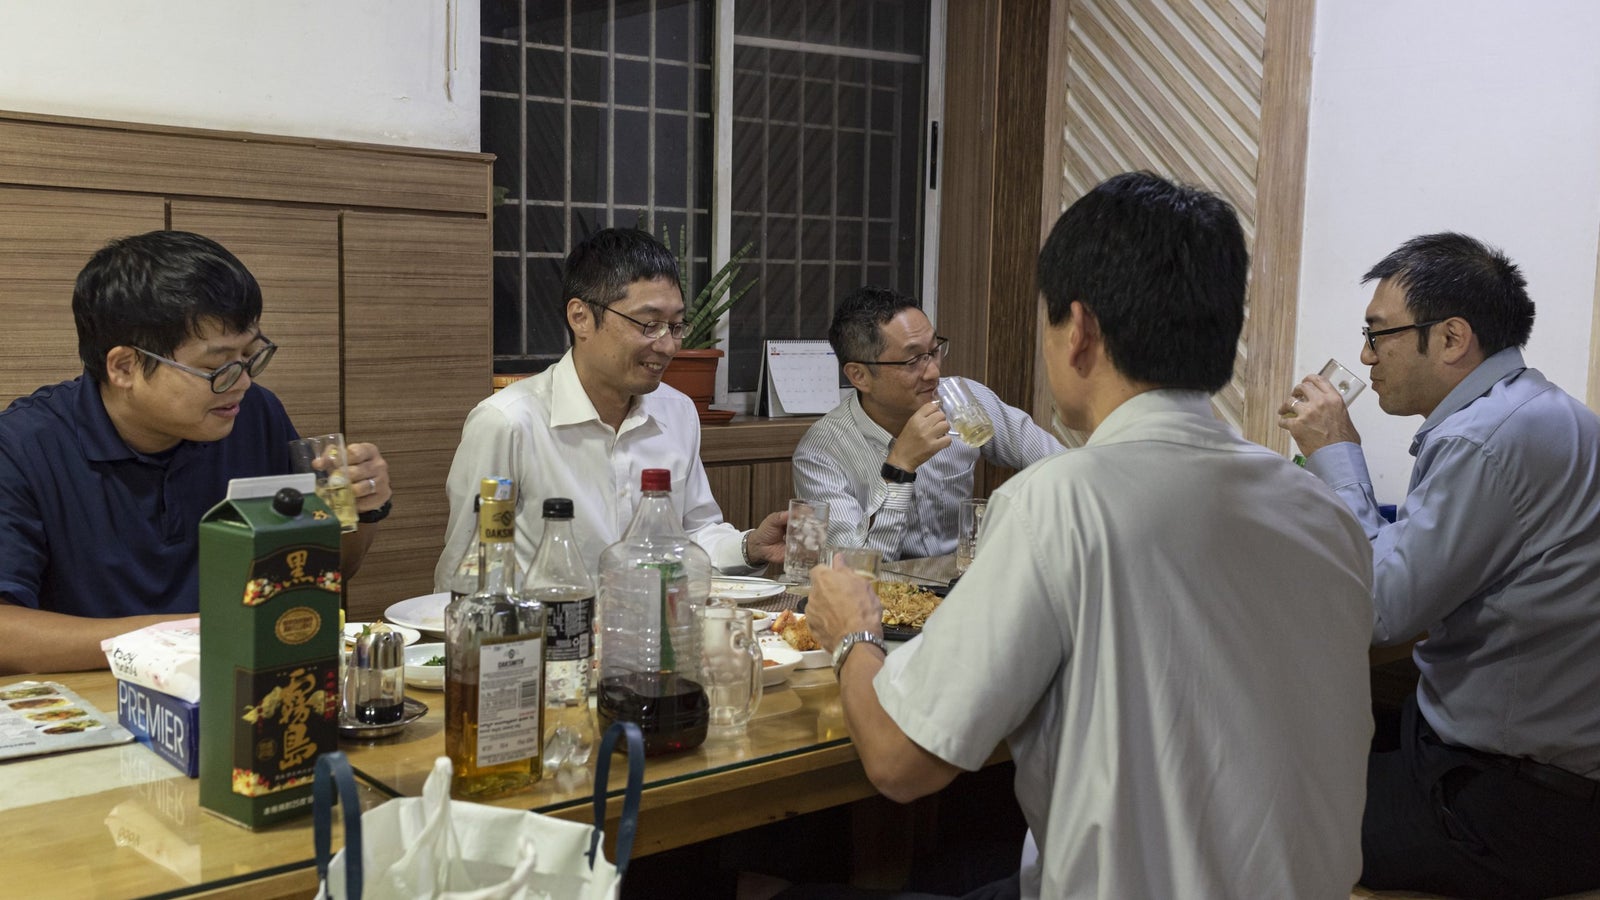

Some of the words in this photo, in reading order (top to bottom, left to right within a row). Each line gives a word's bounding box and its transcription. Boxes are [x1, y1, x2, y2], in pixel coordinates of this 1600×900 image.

[286, 549, 315, 587] 黒
[119, 681, 184, 759] PREMIER
[279, 668, 316, 771] 霧島
